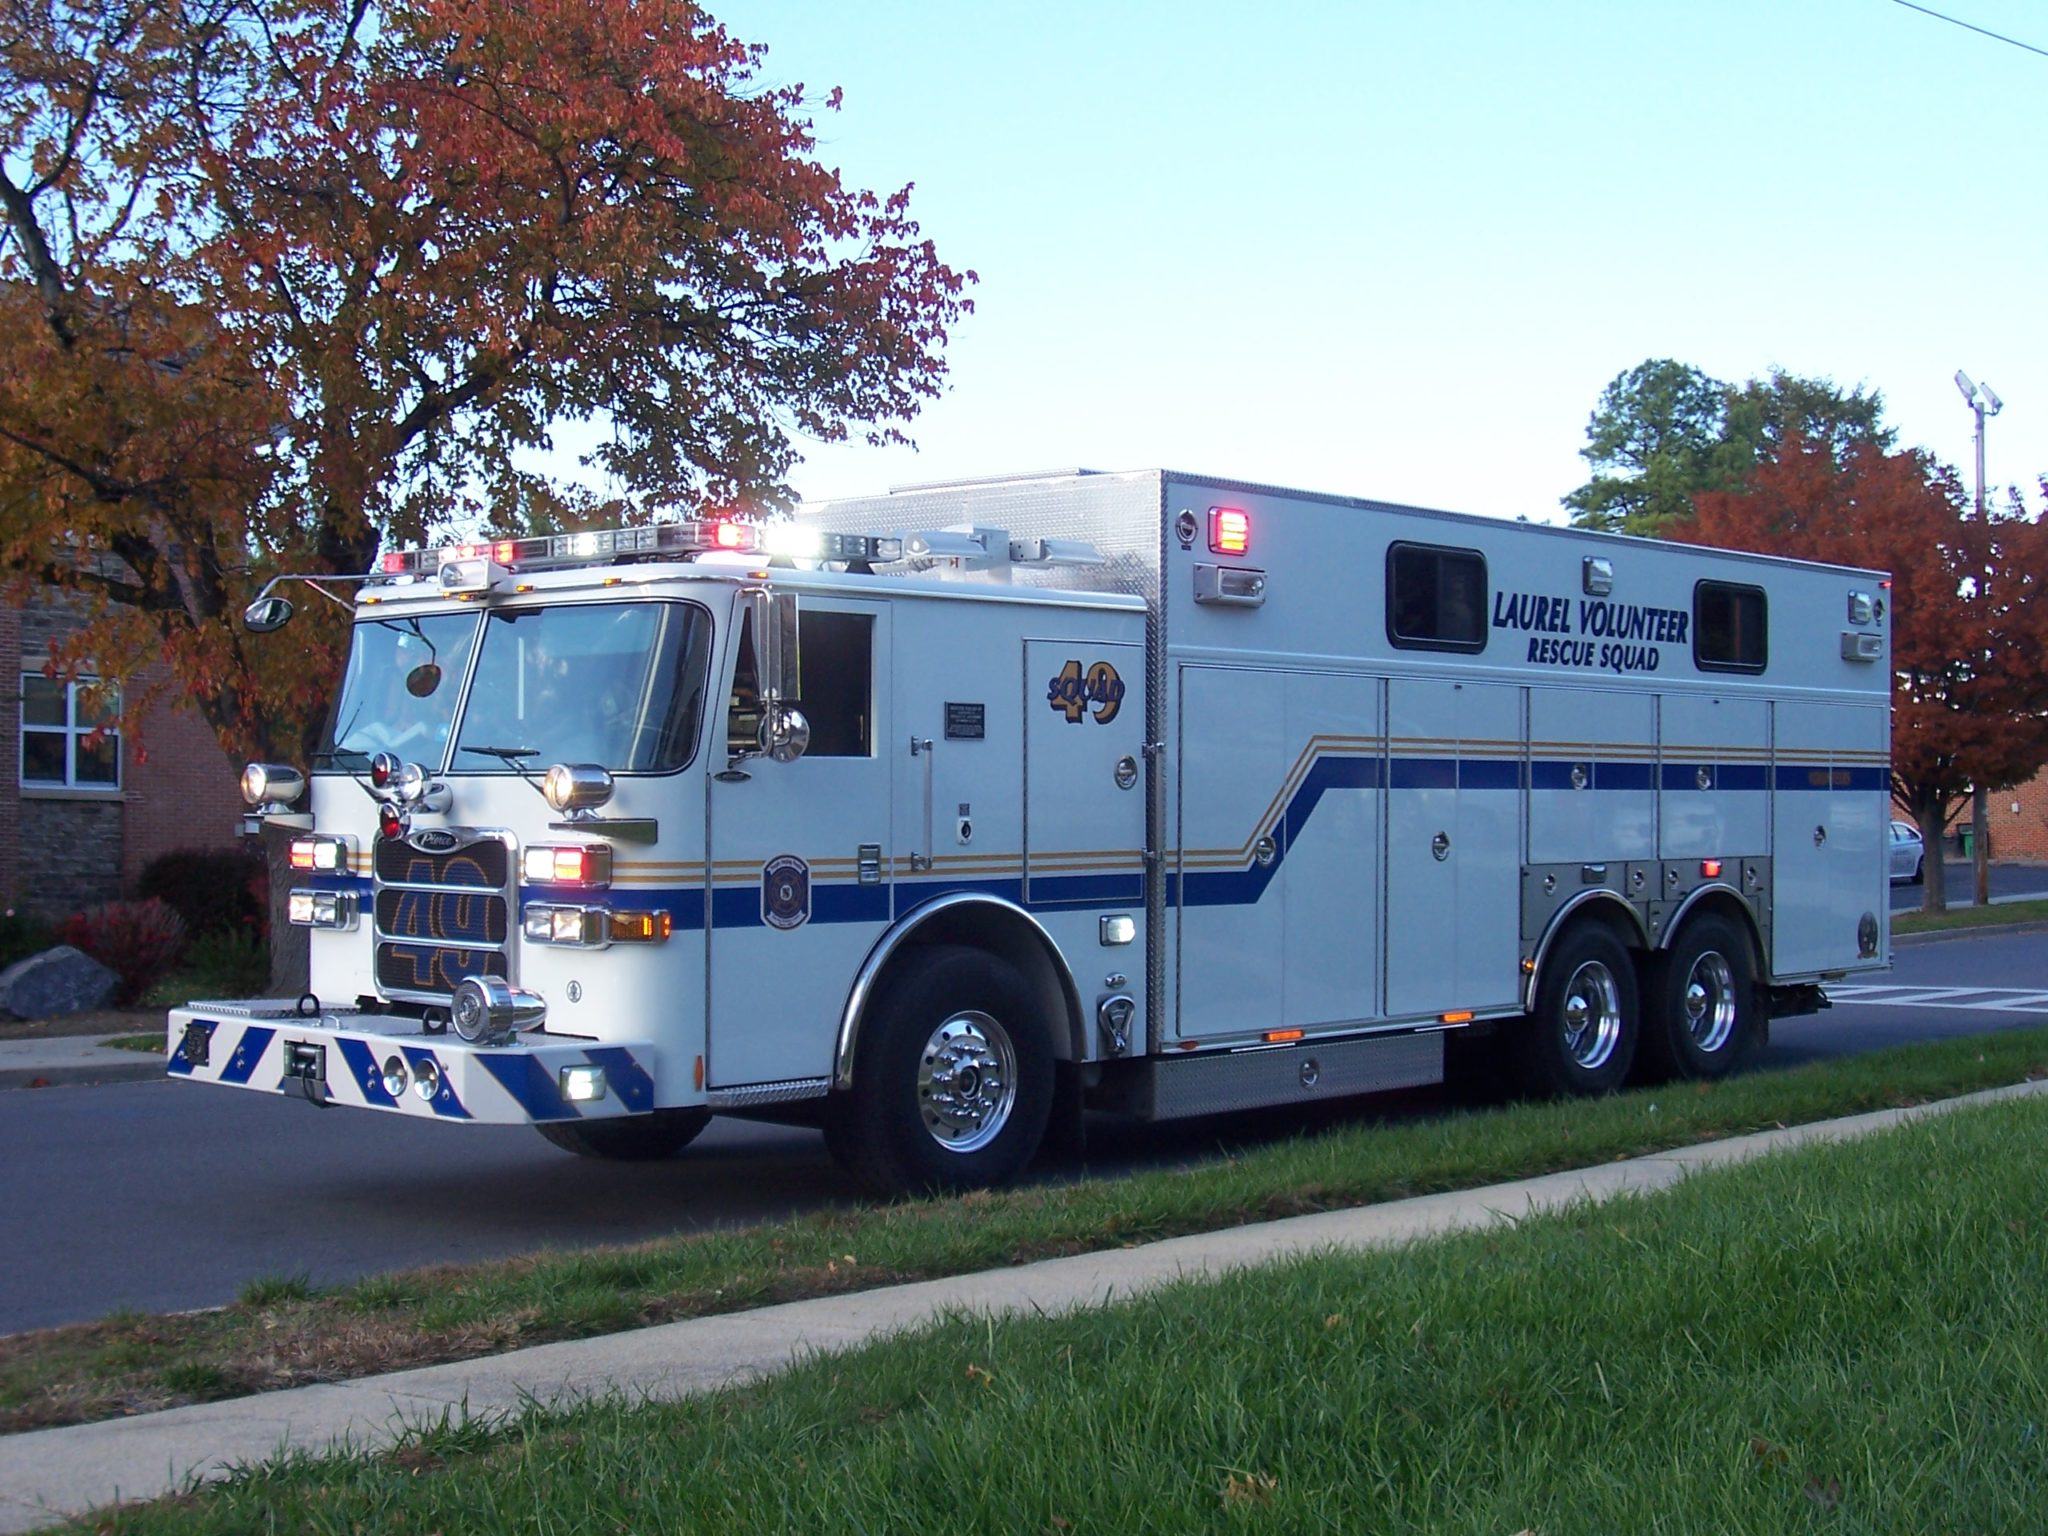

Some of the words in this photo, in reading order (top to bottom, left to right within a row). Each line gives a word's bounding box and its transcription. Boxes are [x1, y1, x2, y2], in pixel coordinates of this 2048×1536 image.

[1493, 591, 1571, 634] LAUREL
[1580, 600, 1689, 644] VOLUNTEER
[1527, 637, 1596, 667] RESCUE
[1600, 643, 1660, 674] SQUAD
[1047, 677, 1126, 706] SQUAD
[1050, 660, 1122, 725] 49
[420, 832, 454, 846] Pierce
[391, 856, 490, 989] 49
